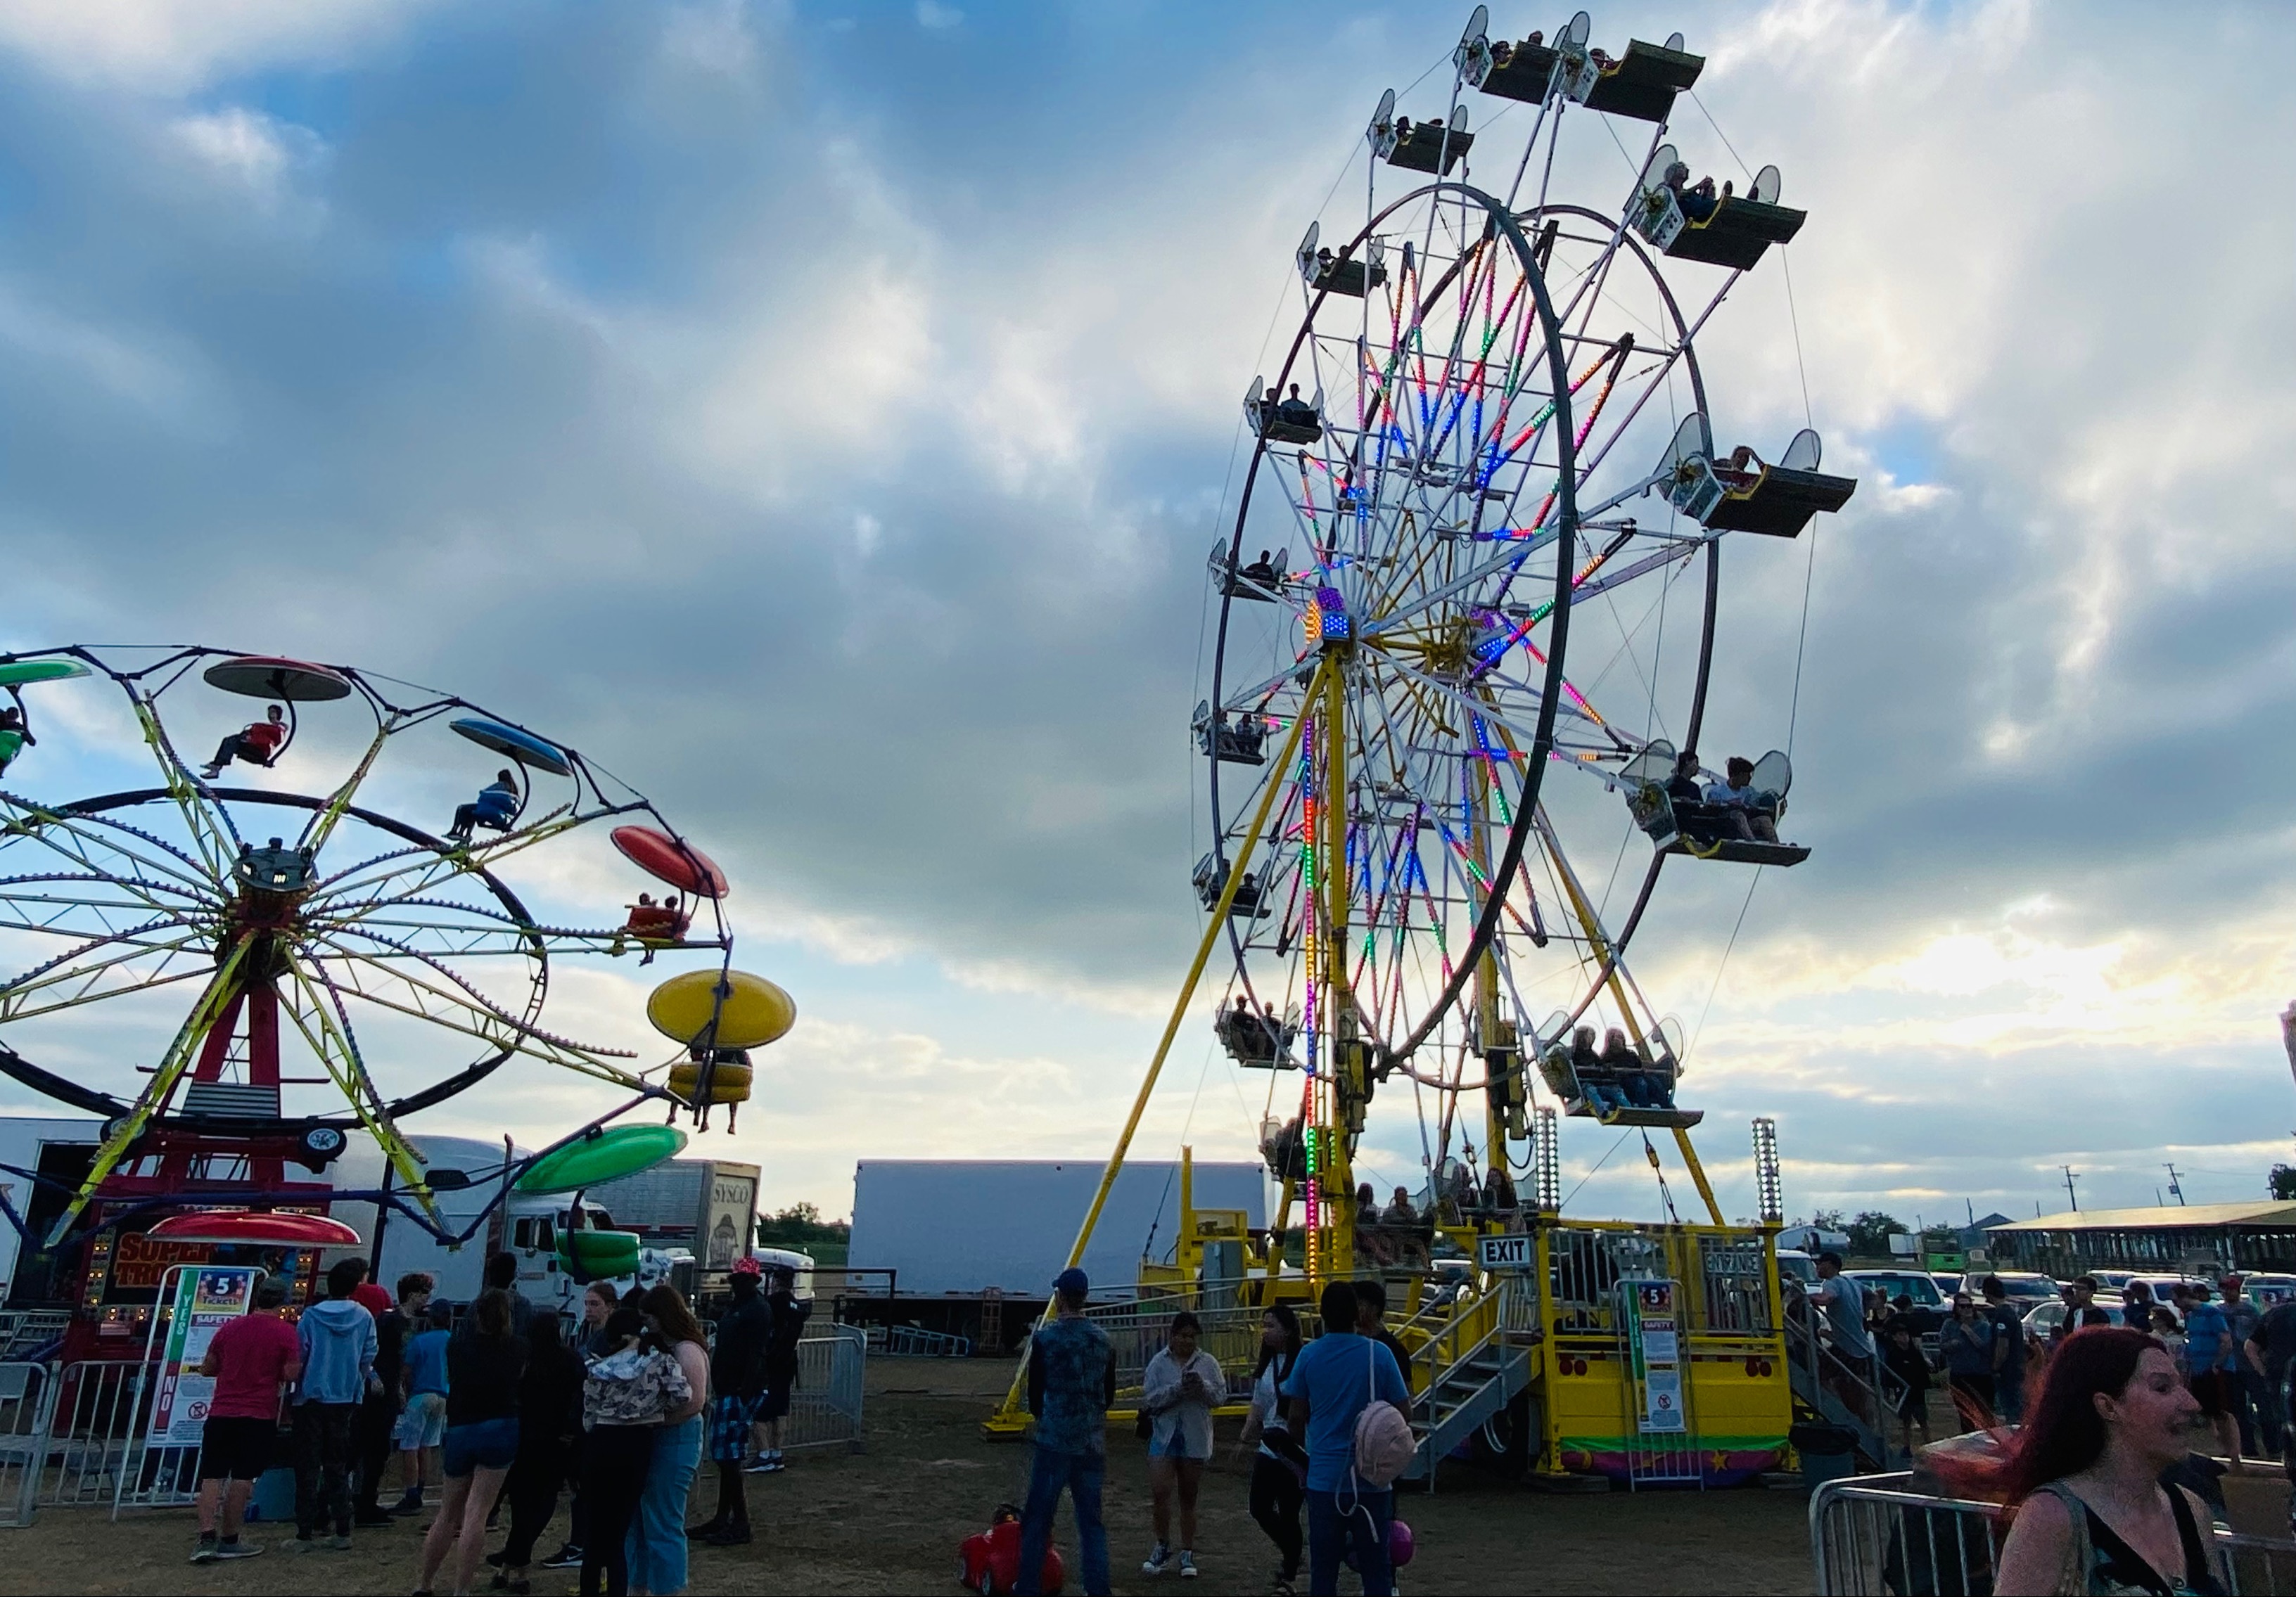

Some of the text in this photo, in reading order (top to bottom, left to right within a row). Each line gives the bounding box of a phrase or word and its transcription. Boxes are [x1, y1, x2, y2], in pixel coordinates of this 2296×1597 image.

[713, 1184, 748, 1203] SYSCO
[1486, 1240, 1524, 1262] EXIT
[215, 1277, 230, 1295] 5
[1650, 1288, 1660, 1304] 5
[176, 1294, 192, 1335] YES
[160, 1375, 176, 1412] NO
